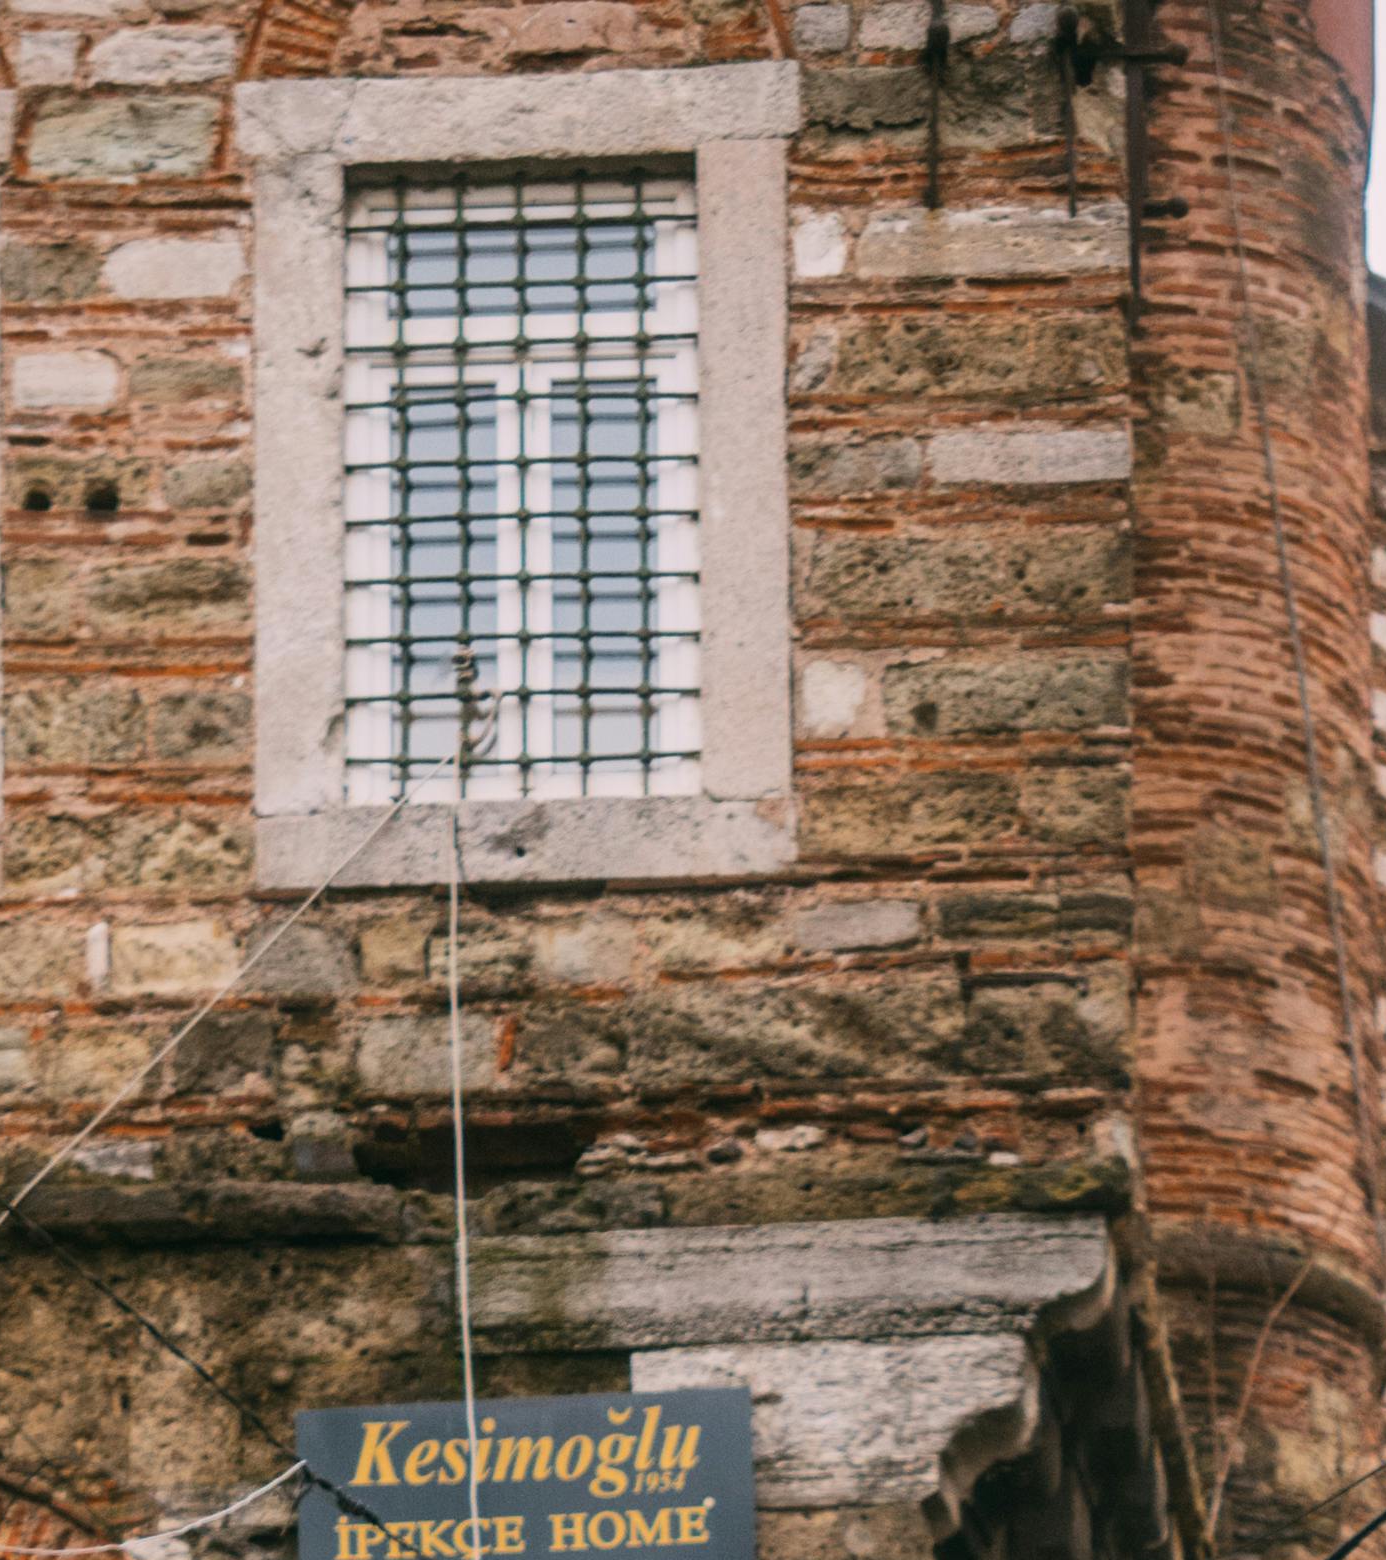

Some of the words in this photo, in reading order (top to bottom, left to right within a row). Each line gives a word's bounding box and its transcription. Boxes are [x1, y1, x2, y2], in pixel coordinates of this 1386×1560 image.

[348, 1405, 702, 1499] Kesimoğlu
[632, 1471, 689, 1496] 1954
[548, 1506, 710, 1553] HOME
